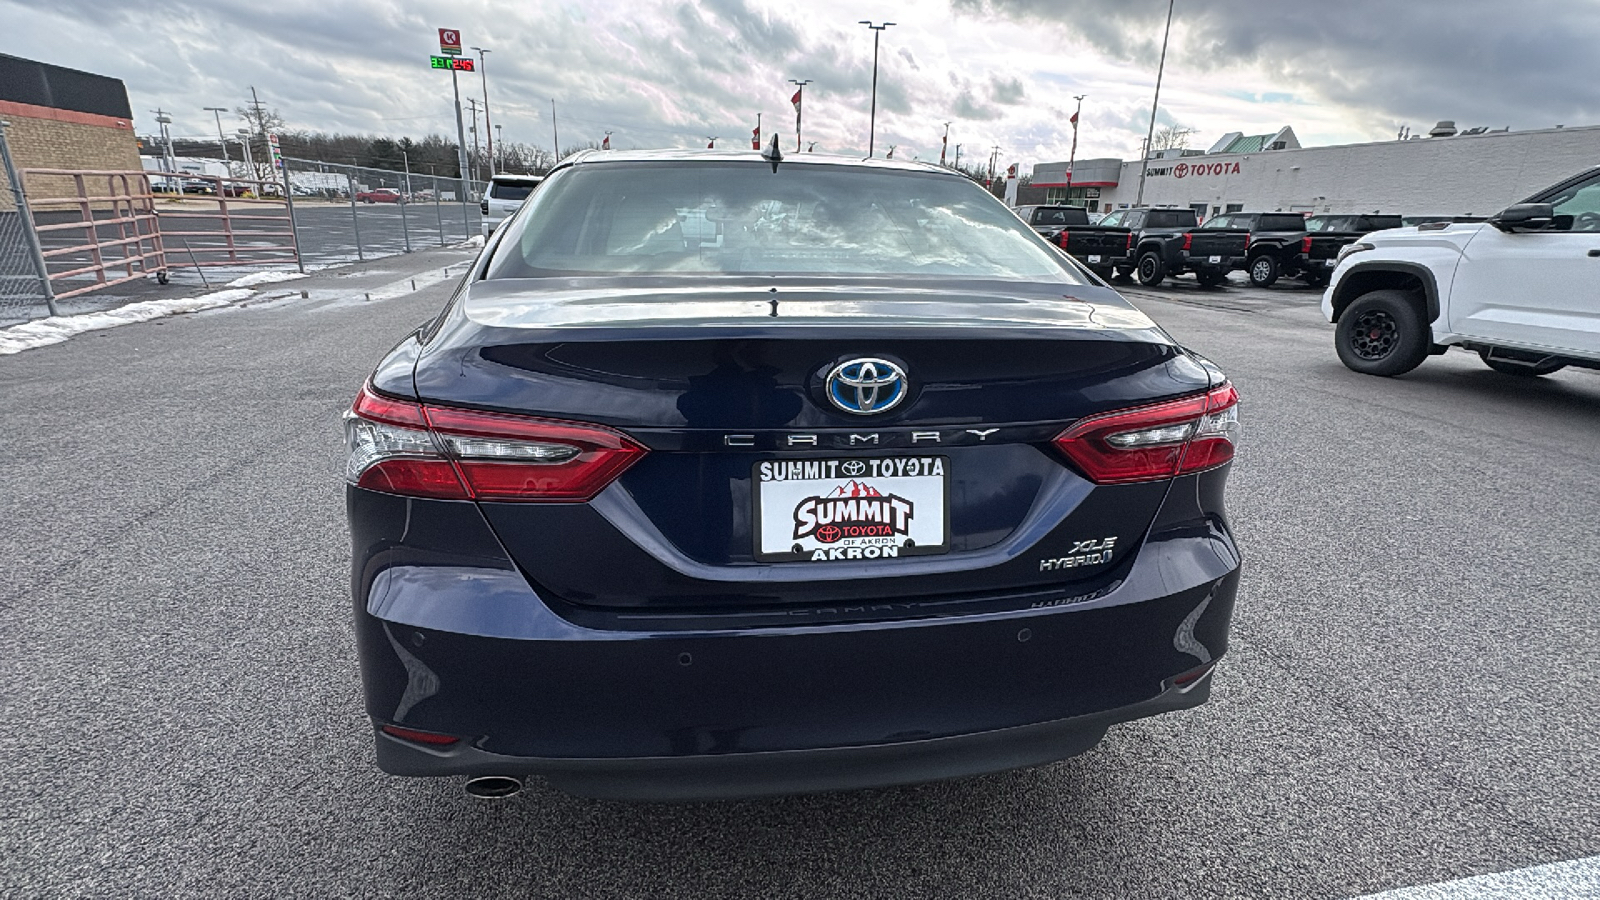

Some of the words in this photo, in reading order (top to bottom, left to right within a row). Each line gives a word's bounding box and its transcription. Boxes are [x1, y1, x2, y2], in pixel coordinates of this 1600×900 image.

[1146, 167, 1174, 177] SUMMIT
[1190, 162, 1241, 176] TOYOTA
[724, 428, 1000, 446] CAMRY
[760, 460, 839, 481] SUMMIT
[869, 457, 944, 478] TOYOTA
[796, 497, 912, 537] SUMMIT
[843, 525, 892, 537] TOYOTA
[843, 538, 857, 546] OF
[859, 537, 896, 546] AKRON
[1067, 536, 1118, 554] XLE
[811, 546, 898, 561] AKRON
[1039, 553, 1102, 572] HYBRID
